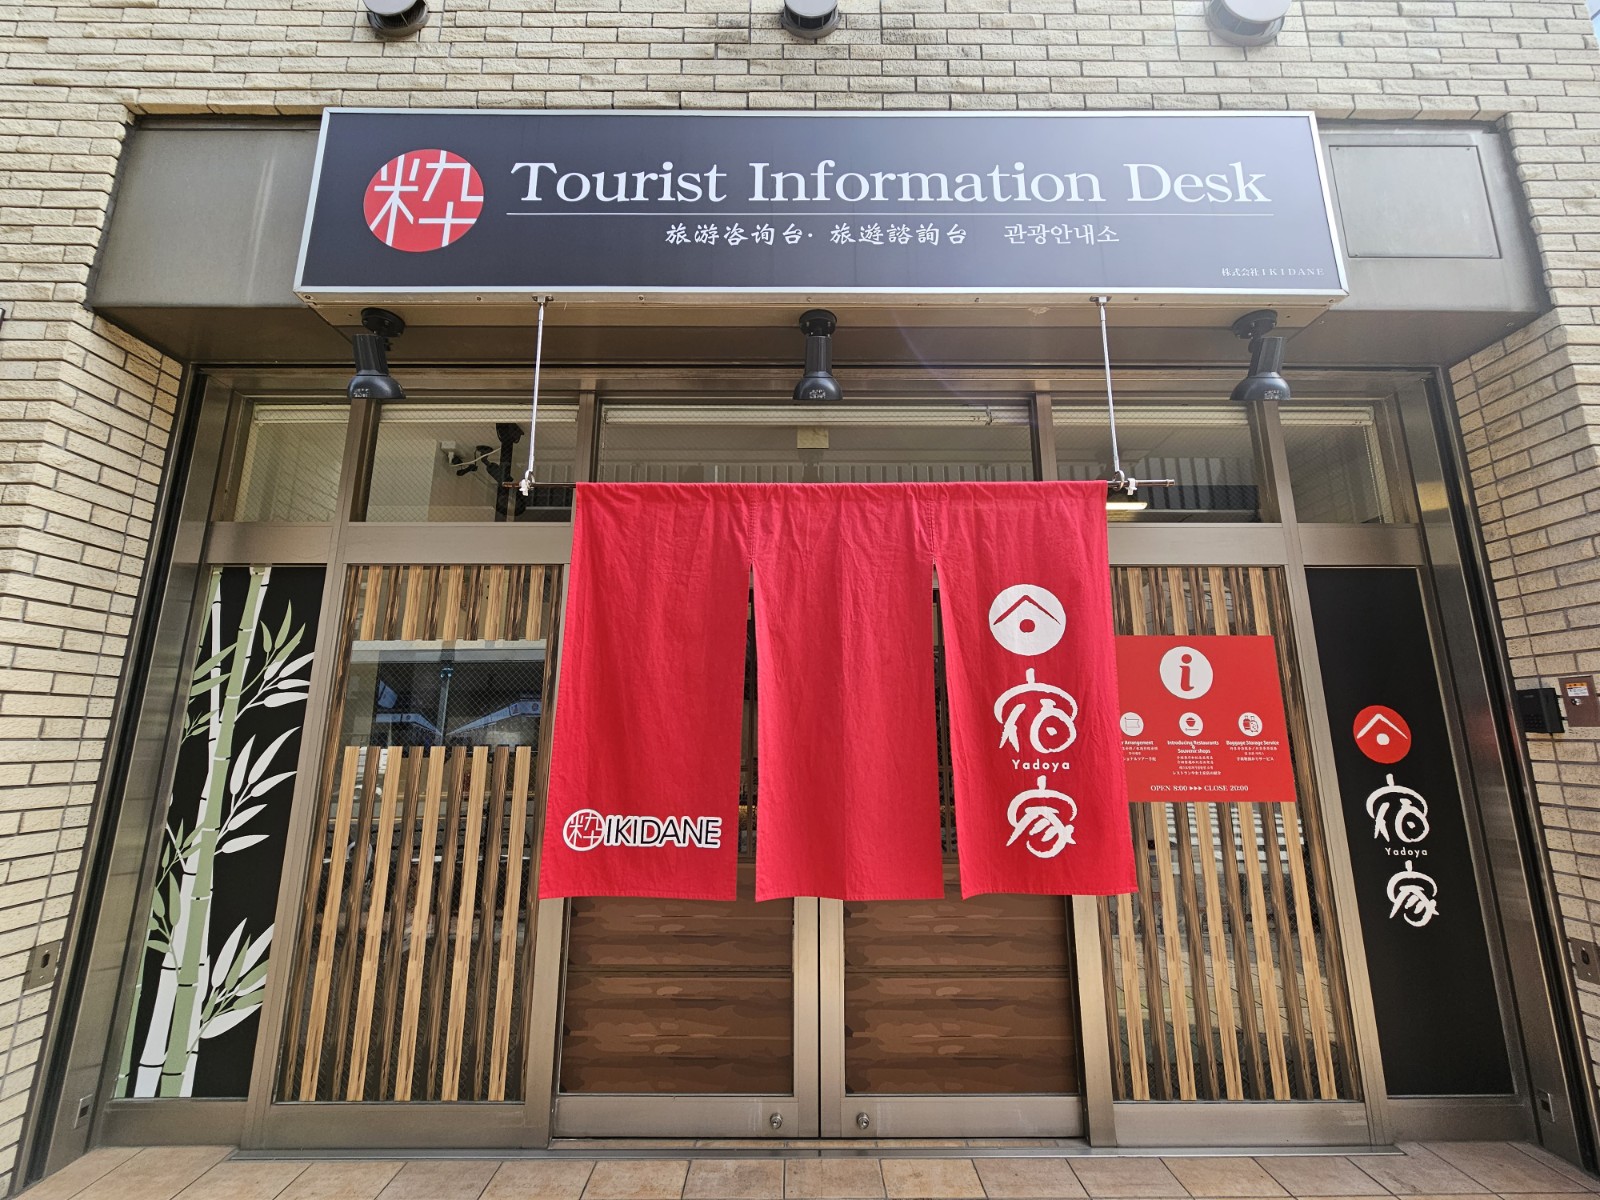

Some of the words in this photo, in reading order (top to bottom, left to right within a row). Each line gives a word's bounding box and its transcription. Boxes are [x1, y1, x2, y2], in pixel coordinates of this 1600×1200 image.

[510, 160, 728, 203] Tourist
[747, 159, 1107, 203] Information
[1123, 160, 1273, 203] Desk
[829, 223, 968, 246] 旅遊諮詢台
[1003, 223, 1121, 245] 관광안내소
[1011, 758, 1071, 773] Yadoya
[604, 815, 722, 848] IKIDANE
[1385, 847, 1428, 859] Yadoya
